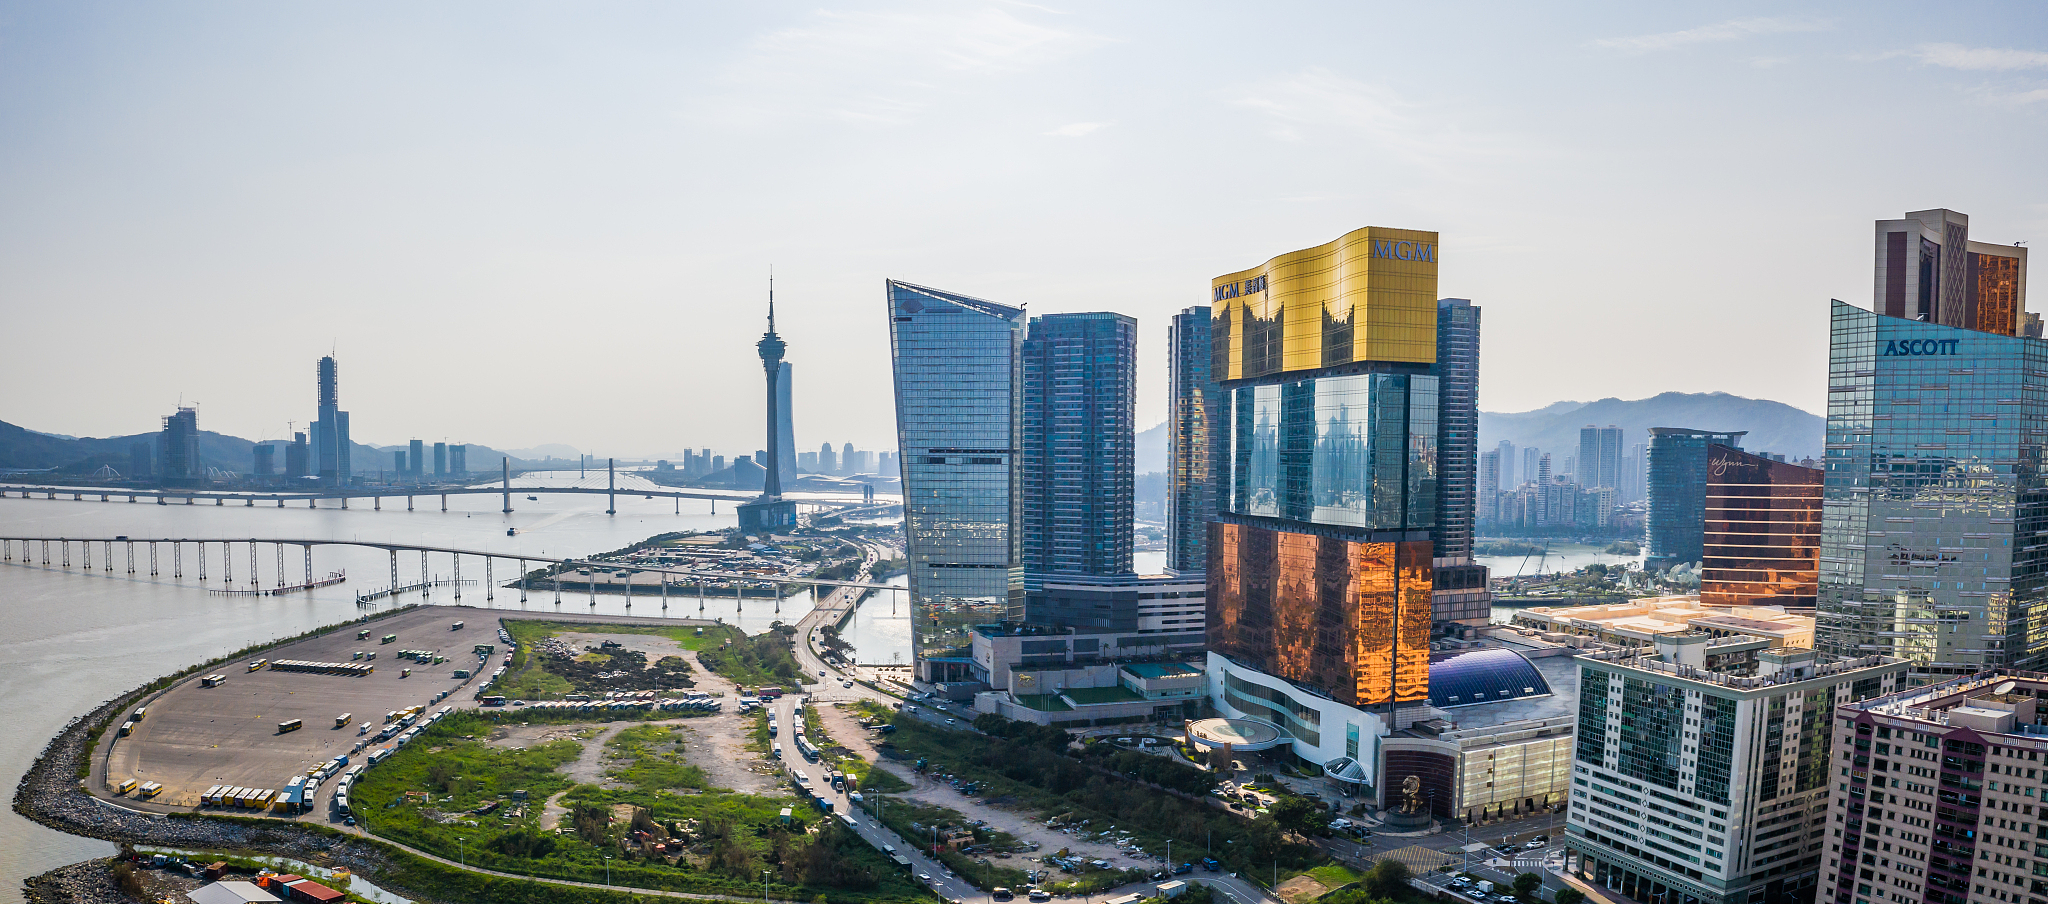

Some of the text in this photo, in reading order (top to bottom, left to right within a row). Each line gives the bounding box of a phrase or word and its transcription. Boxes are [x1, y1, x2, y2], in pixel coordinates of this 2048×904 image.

[1373, 239, 1434, 263] MGM
[1213, 281, 1240, 303] MGM
[1883, 339, 1960, 356] ASCOTT
